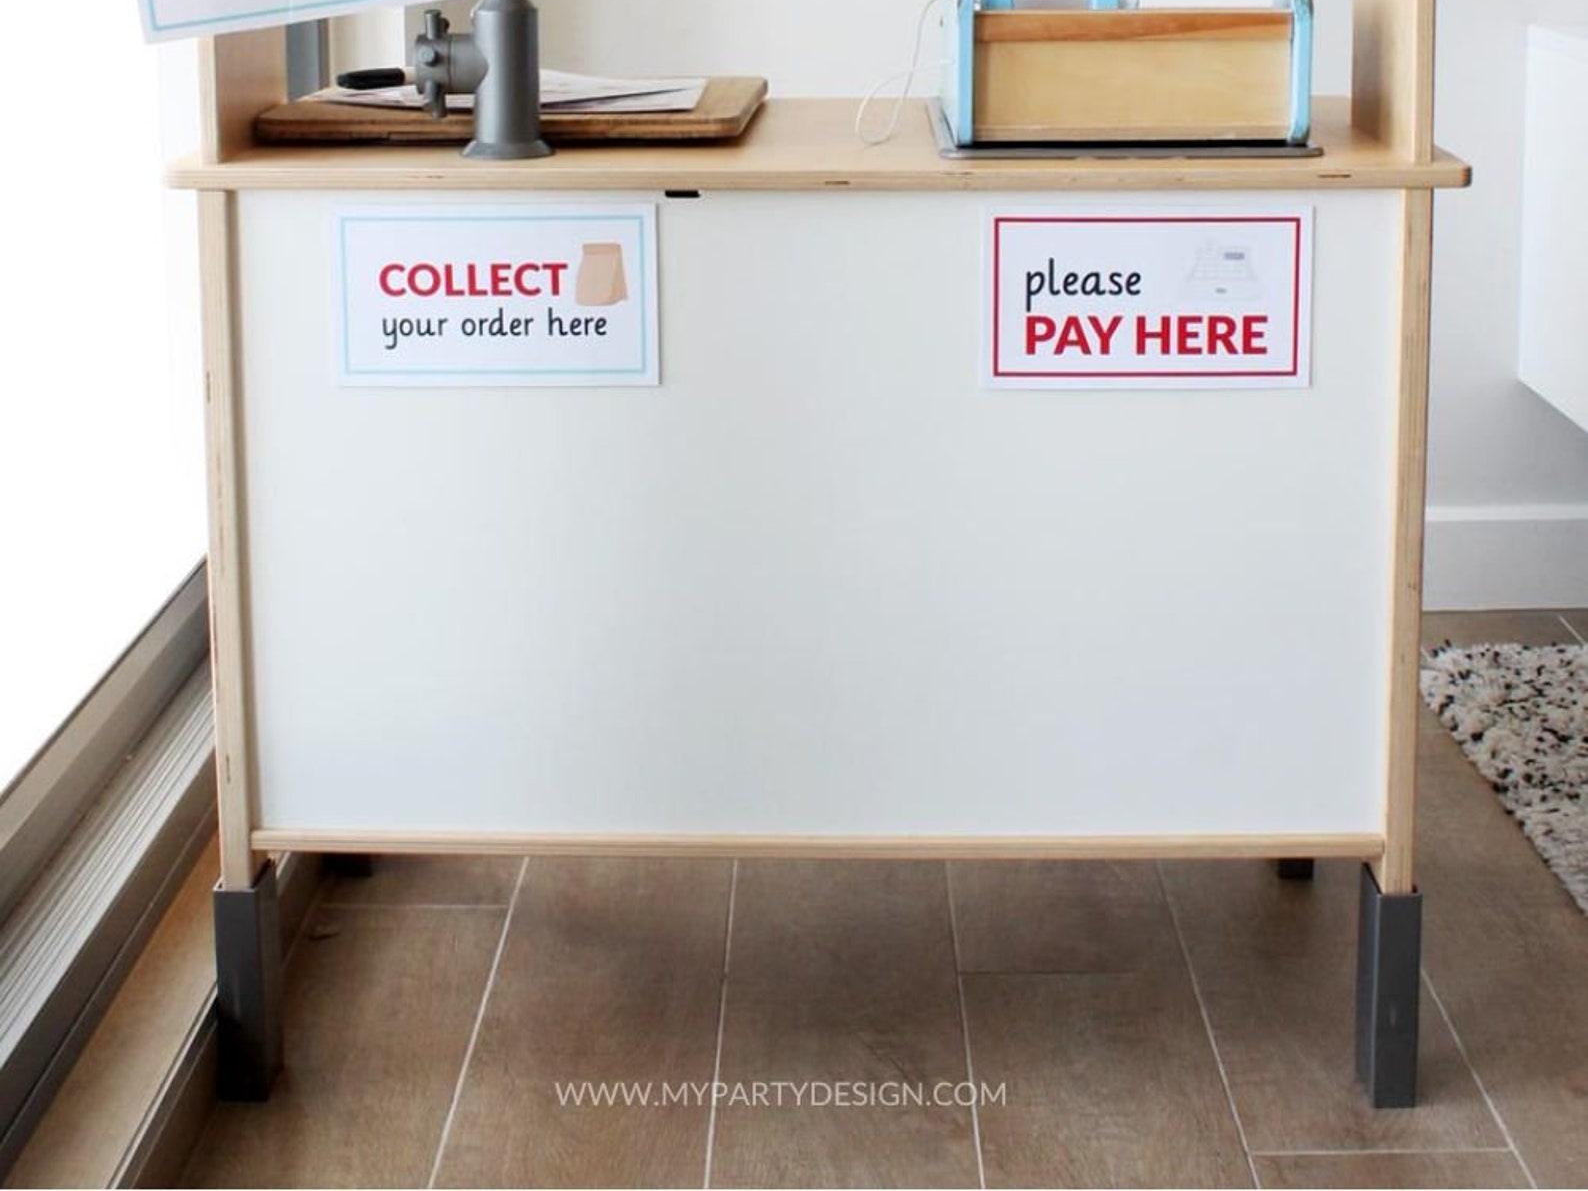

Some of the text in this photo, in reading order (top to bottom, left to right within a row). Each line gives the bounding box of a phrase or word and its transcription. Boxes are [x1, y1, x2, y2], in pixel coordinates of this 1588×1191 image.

[379, 263, 568, 297] COLLECT
[1026, 257, 1142, 313] please
[382, 307, 607, 350] your order here
[1025, 315, 1268, 354] PAY HERE
